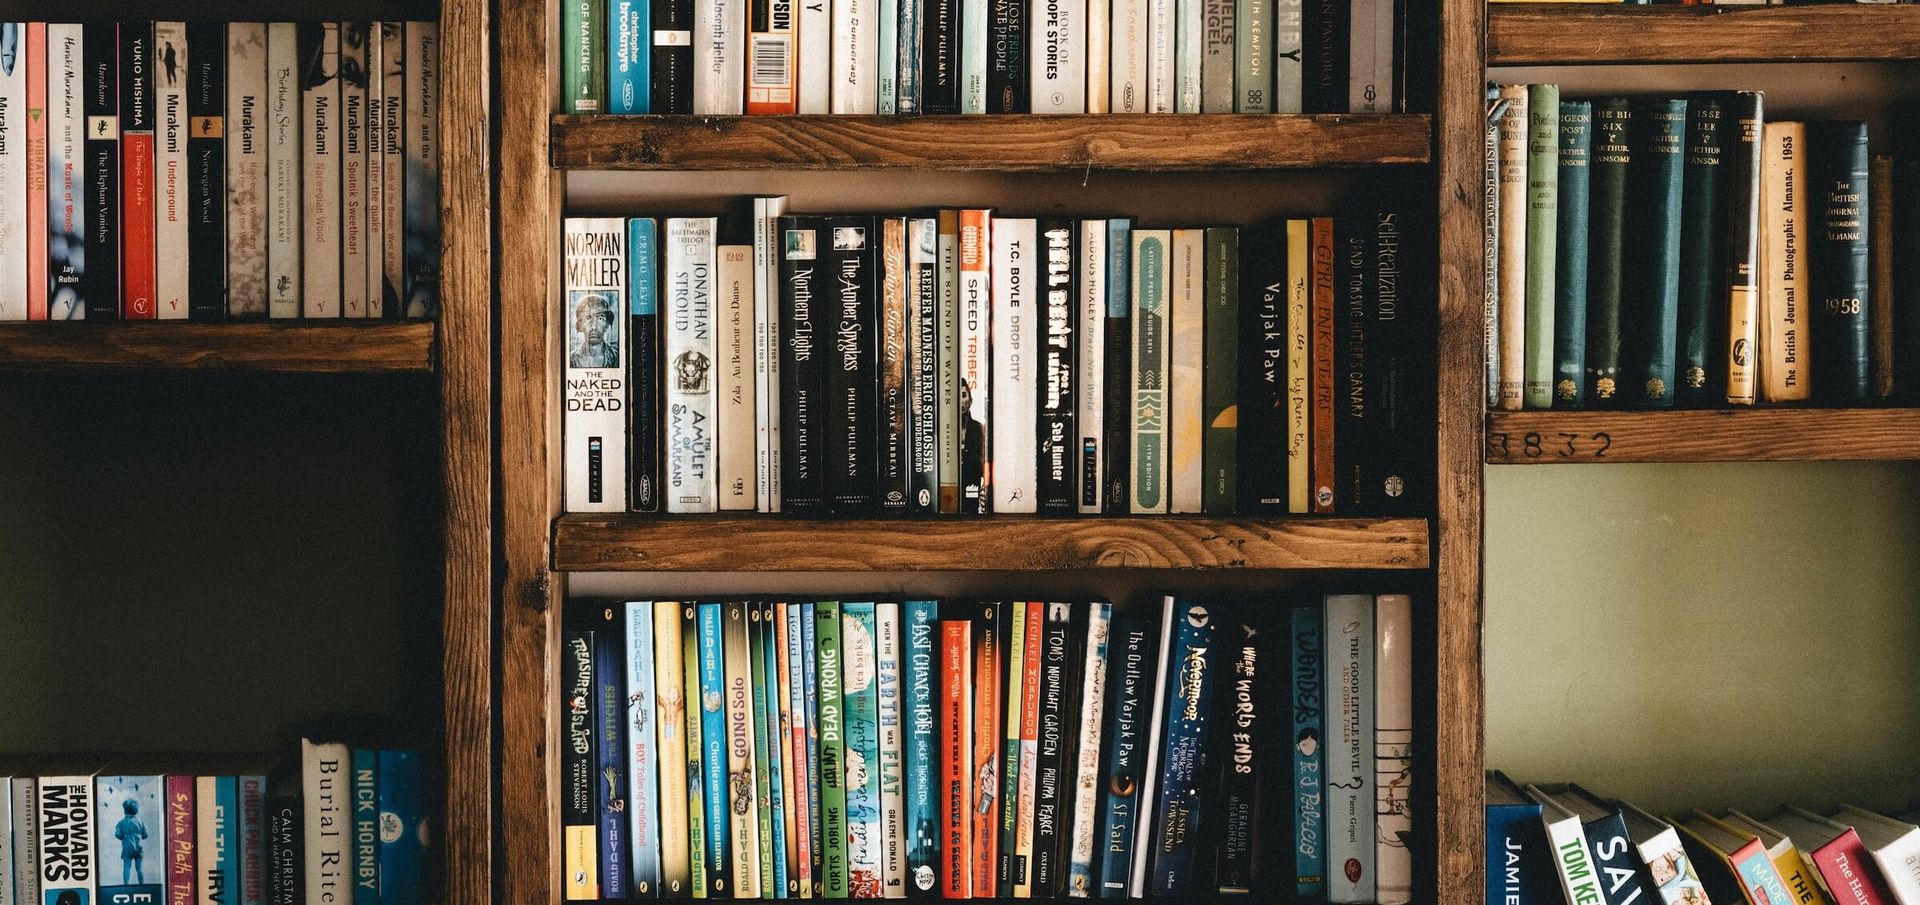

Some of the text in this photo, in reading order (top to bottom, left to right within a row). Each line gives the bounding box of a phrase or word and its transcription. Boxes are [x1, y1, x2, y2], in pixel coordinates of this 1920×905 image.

[580, 3, 589, 73] OF NANKING
[617, 2, 631, 73] brookmyre
[630, 11, 640, 64] christopher
[713, 41, 725, 74] Heller
[849, 18, 859, 85] Democracy
[939, 35, 948, 86] PULLMAN
[994, 27, 1007, 72] PEOPLE
[1008, 2, 1020, 80] LOSE FRIENDS
[1047, 31, 1058, 80] STORIES
[1060, 11, 1069, 45] BOOK
[1252, 21, 1261, 76] KEMPTON
[134, 39, 143, 125] YUKIO MISHIMA
[274, 68, 291, 146] Birthday Stories
[65, 125, 73, 160] and the
[165, 95, 179, 222] Murakami Underground
[243, 96, 255, 154] Murakami
[387, 96, 399, 154] Murakami
[1561, 126, 1585, 134] POST
[1602, 122, 1623, 131] SIX
[1698, 123, 1716, 131] LEE
[96, 150, 108, 243] The Elephant Vanishes
[200, 150, 211, 223] Norwegian Wood
[313, 97, 328, 243] Murakami Norwegian Wood
[347, 96, 360, 256] Murakami Sputnik Sweetheart
[368, 99, 381, 233] Murakami after the quake
[567, 232, 621, 256] NORMAN
[567, 258, 621, 288] MAILER
[639, 235, 648, 306] PRIMO LEVI
[1316, 245, 1332, 298] GIRL
[1782, 136, 1797, 388] The British Journal Photographic Almanac, 1953
[675, 272, 690, 331] STROUD
[692, 262, 708, 341] JONATHAN
[789, 267, 814, 362] Northern Lights
[836, 256, 862, 371] The Amber Spyglass
[1010, 241, 1020, 382] T.C. BOYLE DROP CITY
[1044, 229, 1073, 348] HELL BENT
[1088, 280, 1097, 322] HUXLEY
[1825, 298, 1861, 316] 1958
[730, 281, 741, 405] Zola Dames
[967, 279, 978, 390] SPEED TRIBES
[1261, 282, 1281, 383] Varjak Paw
[567, 380, 622, 390] NAKED
[567, 399, 622, 412] DEAD
[922, 269, 933, 473] REEFER MADNESS ERIC SCHLOSSER
[1317, 354, 1332, 414] STARS
[1351, 372, 1364, 418] CANARY
[672, 403, 687, 487] SAMARKAND
[692, 410, 706, 479] AMULET
[799, 390, 808, 479] PHILIP PULLMAN
[848, 387, 857, 476] PHILIP PULLMAN
[1051, 422, 1064, 481] Seb Hunter
[1028, 612, 1039, 663] MICHAEL
[571, 637, 592, 755] TREASURE ISLAND
[732, 677, 746, 759] GOING Solo
[821, 649, 838, 742] DEAD WRONG
[880, 621, 900, 796] WHEN THE EARTH WAS FLAT
[1043, 629, 1065, 756] TOM'S MIDNIGHT GARDEN
[1118, 631, 1145, 767] The Outlaw Varjak Paw
[1232, 679, 1256, 774] WORLD ENDS
[1351, 637, 1360, 772] THE GOOD LITTLE DEVIL
[636, 743, 646, 764] BOY
[711, 741, 721, 778] Charlie
[69, 786, 87, 794] THE
[319, 759, 339, 838] Burial
[580, 791, 588, 813] LOUIS
[1039, 767, 1056, 835] PHILIPPA PEARCE
[43, 786, 71, 882] MARKS
[69, 794, 89, 882] HOWARD
[172, 793, 194, 875] Sylvia Plath
[281, 808, 293, 844] CALM
[356, 769, 376, 889] NICK HORNBY
[828, 807, 841, 892] CURTIS JOBLING
[888, 809, 897, 871] GRAEME DONALD
[1110, 823, 1124, 852] Said
[1560, 838, 1591, 882] TOM
[1040, 851, 1048, 884] OXFORD
[1505, 837, 1522, 905] JAMIE
[1790, 870, 1814, 905] THE
[1834, 852, 1851, 878] The
